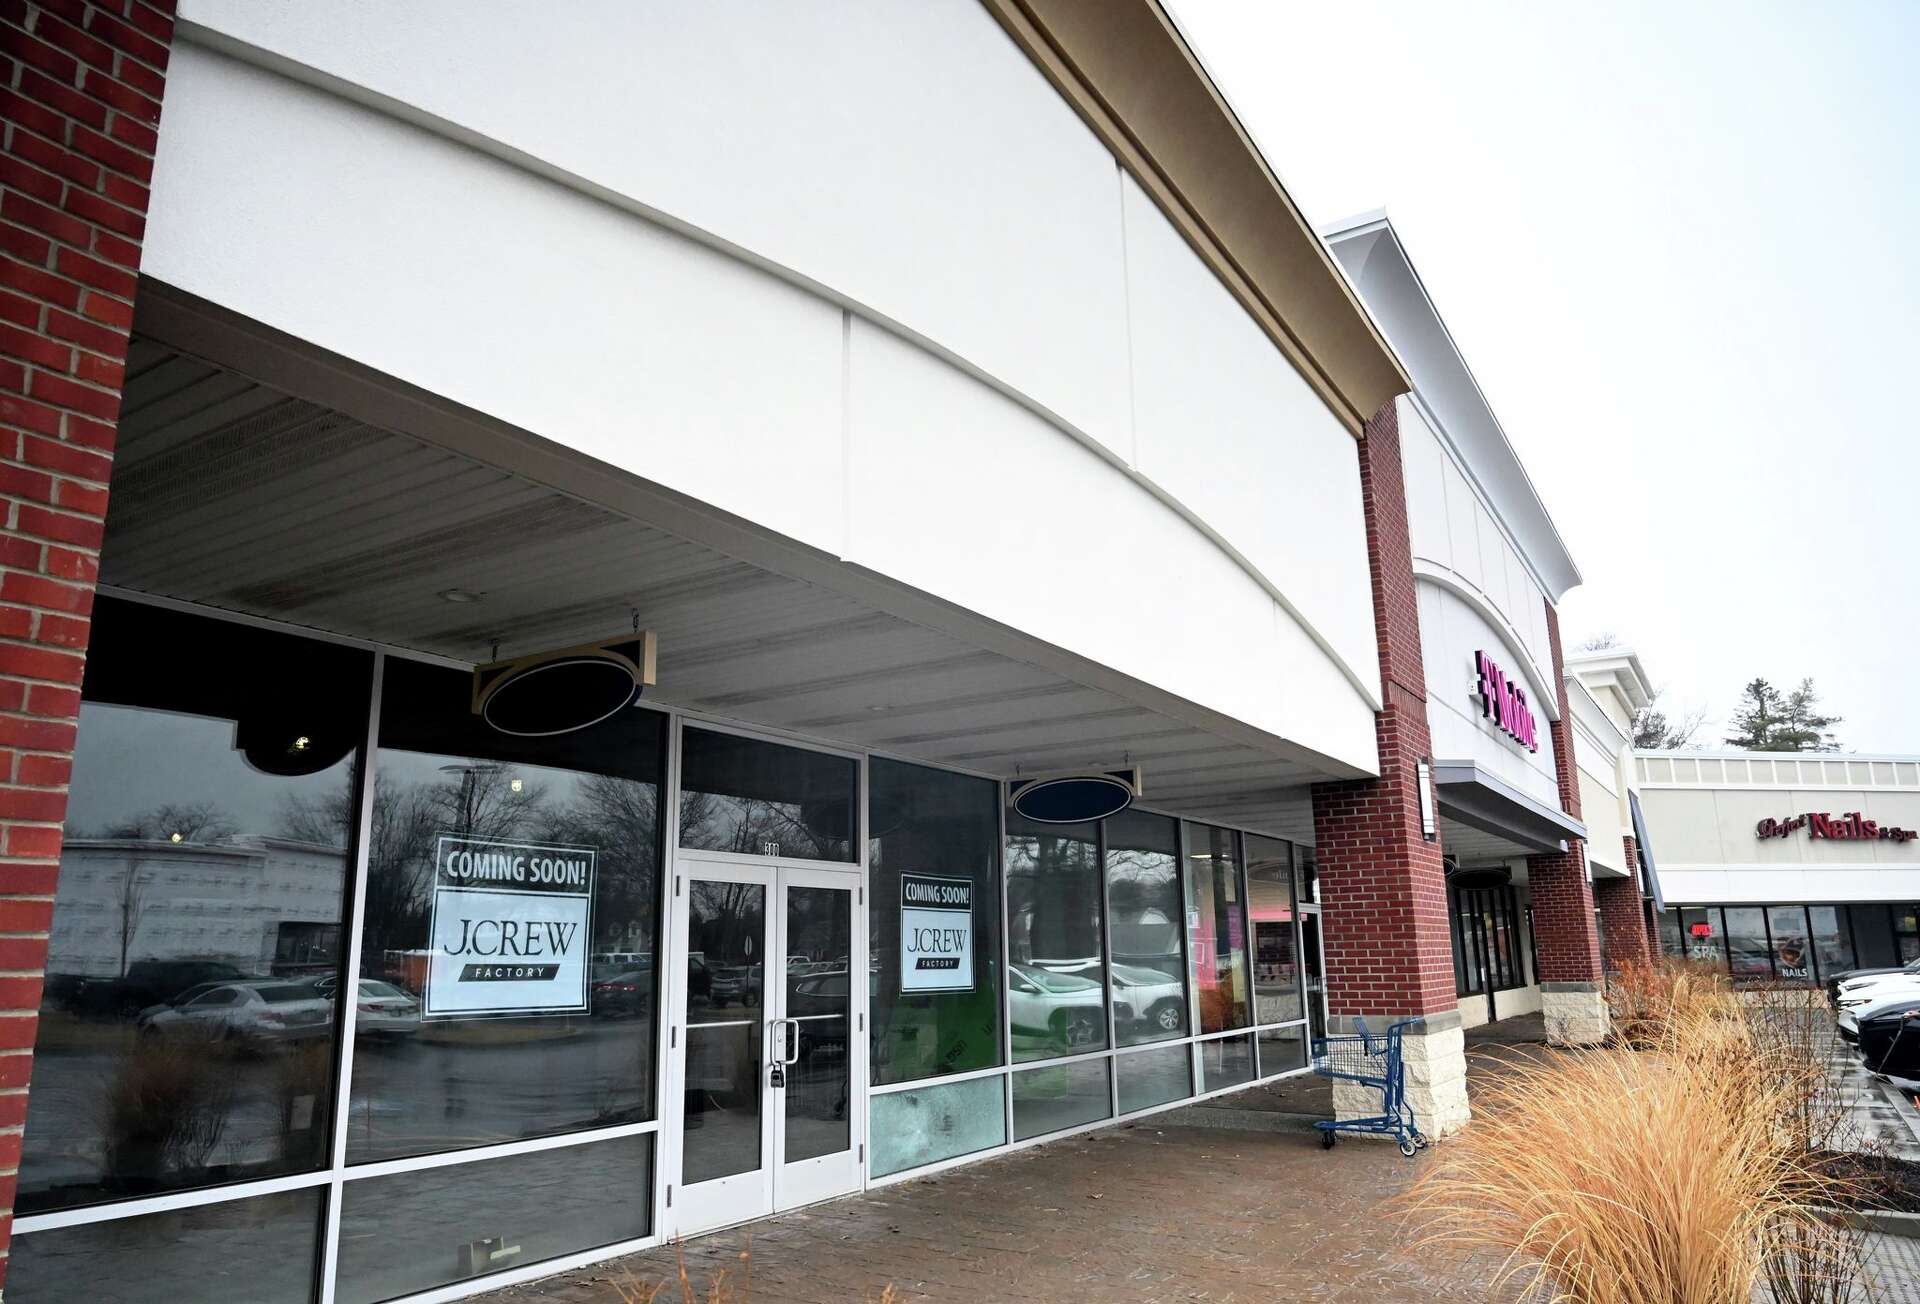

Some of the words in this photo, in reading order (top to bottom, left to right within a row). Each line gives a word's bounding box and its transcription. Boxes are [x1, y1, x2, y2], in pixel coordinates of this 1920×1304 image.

[1806, 811, 1878, 841] Nails
[447, 851, 525, 880] COMING
[530, 858, 586, 885] SOON!
[906, 883, 939, 903] COMING
[942, 887, 969, 904] SOON!
[443, 919, 578, 956] J.CREW
[907, 928, 967, 953] J.CREW
[475, 968, 545, 978] FACTORY
[1782, 968, 1808, 977] NAILS
